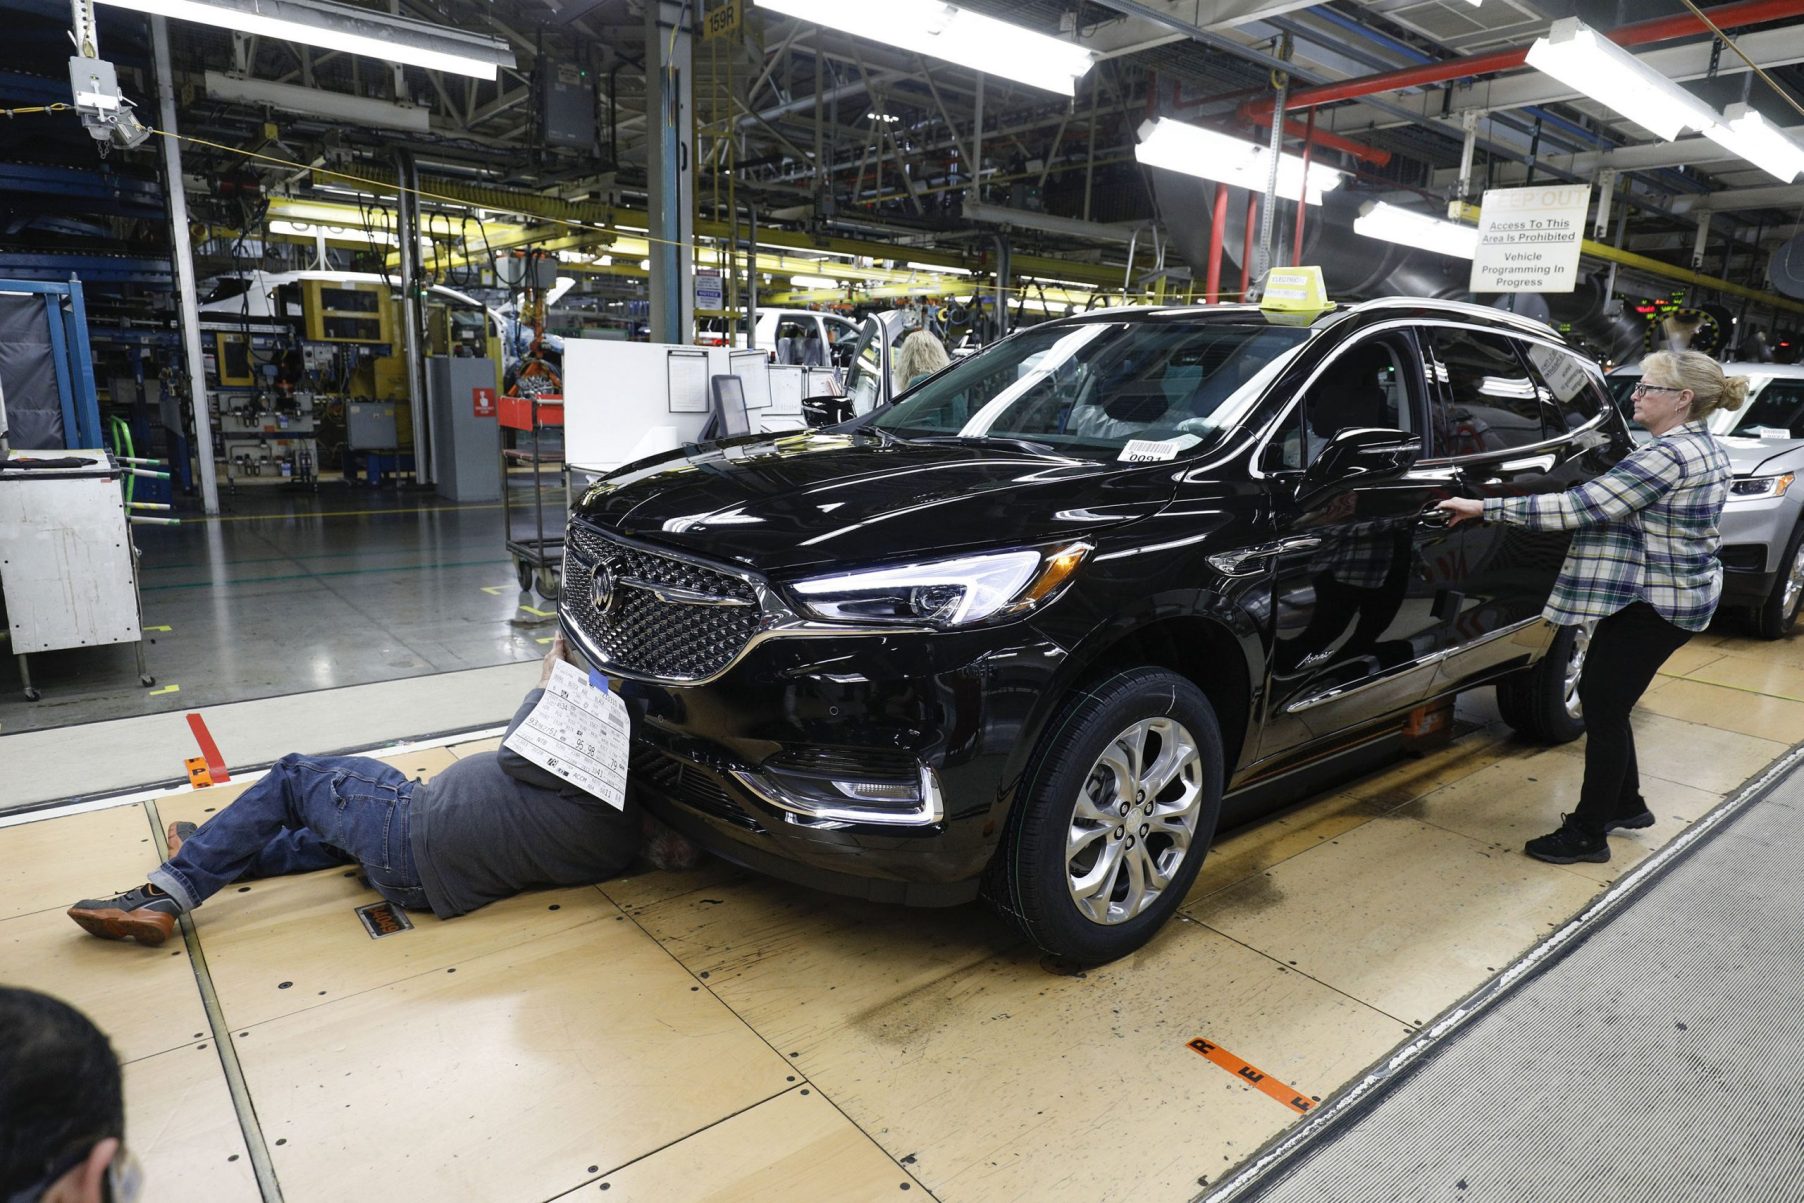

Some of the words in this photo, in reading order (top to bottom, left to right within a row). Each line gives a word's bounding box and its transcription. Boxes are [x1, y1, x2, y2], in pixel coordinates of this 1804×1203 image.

[710, 6, 734, 32] 159R
[1541, 189, 1587, 207] OUT
[1490, 221, 1526, 230] Access
[1530, 219, 1543, 229] To
[1546, 218, 1570, 228] This
[1482, 234, 1504, 243] Area
[1507, 234, 1516, 242] Is
[1518, 232, 1576, 242] Prohibited
[1504, 252, 1542, 261] Vehicle
[1482, 264, 1550, 275] Programming
[1554, 264, 1565, 273] In
[1496, 277, 1543, 288] Progress
